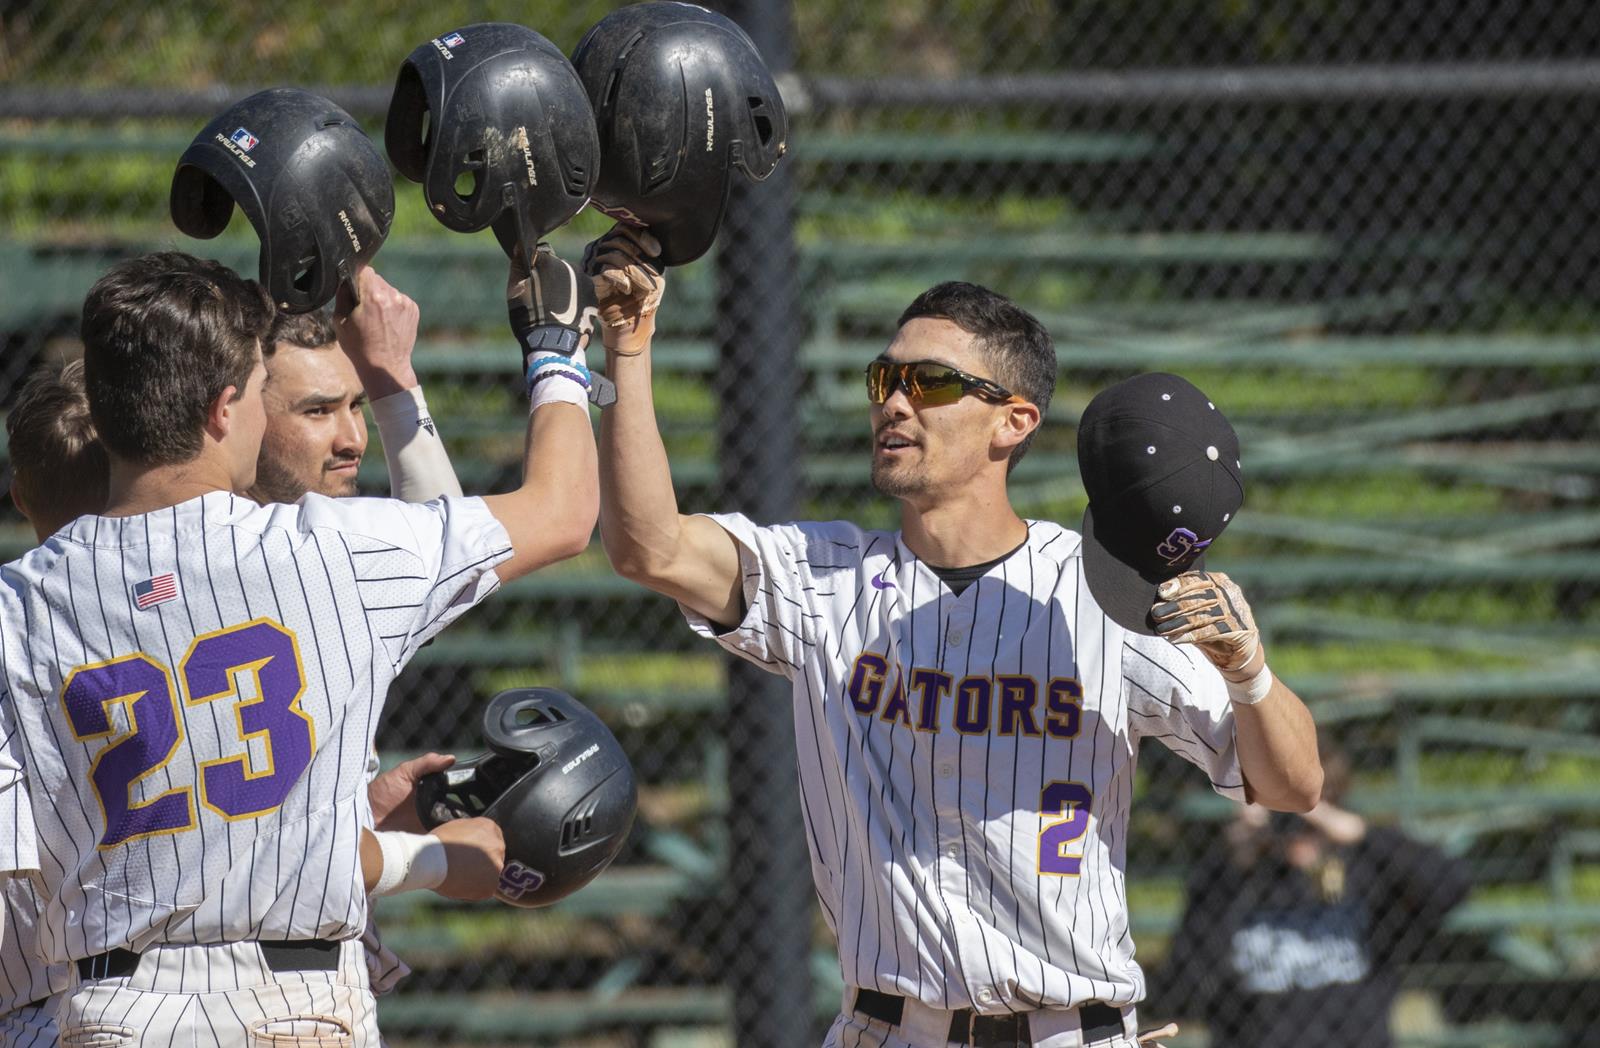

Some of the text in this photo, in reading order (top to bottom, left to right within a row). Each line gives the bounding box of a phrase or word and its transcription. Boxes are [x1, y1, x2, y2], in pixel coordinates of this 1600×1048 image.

[431, 38, 454, 60] LINGS
[704, 87, 714, 151] RAWLINGS
[215, 133, 257, 168] RAWLINGS
[338, 209, 362, 254] RAWLINGS
[848, 652, 1084, 740] GATORS
[60, 616, 317, 851] 23
[562, 743, 600, 775] RAWLINGS
[1036, 779, 1094, 878] 2
